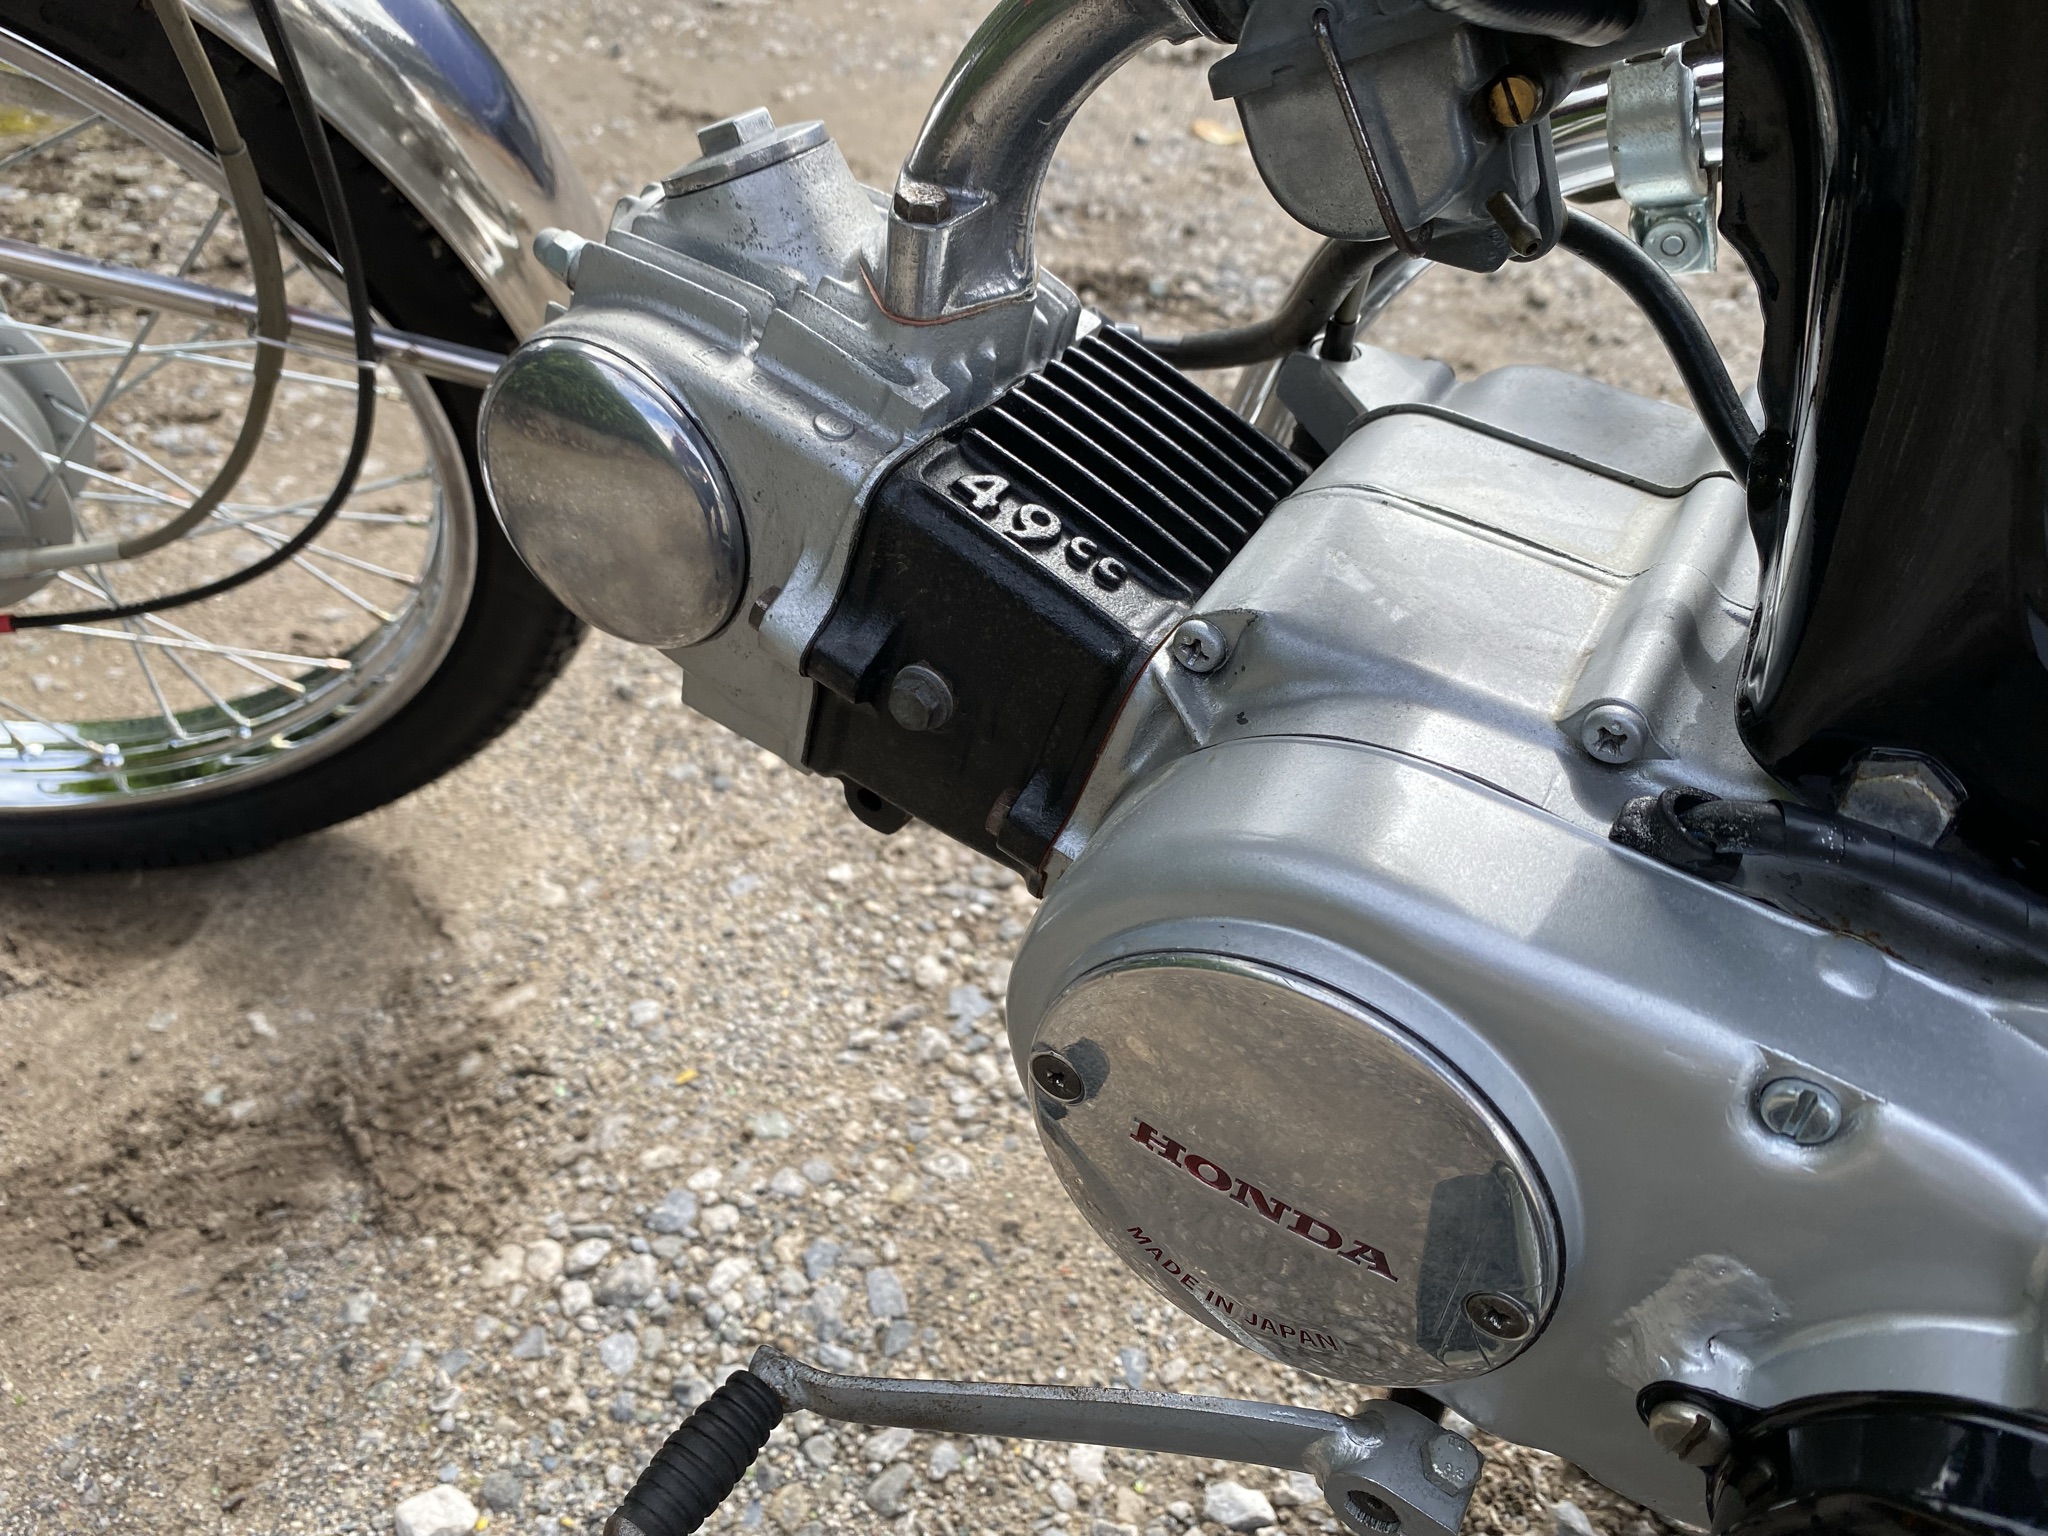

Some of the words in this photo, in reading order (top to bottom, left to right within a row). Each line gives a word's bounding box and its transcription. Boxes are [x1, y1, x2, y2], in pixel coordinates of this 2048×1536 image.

[1130, 1117, 1398, 1282] HONDA
[1127, 1226, 1200, 1290] MADE
[1204, 1290, 1234, 1314] IN
[1245, 1313, 1339, 1350] JAPAN
